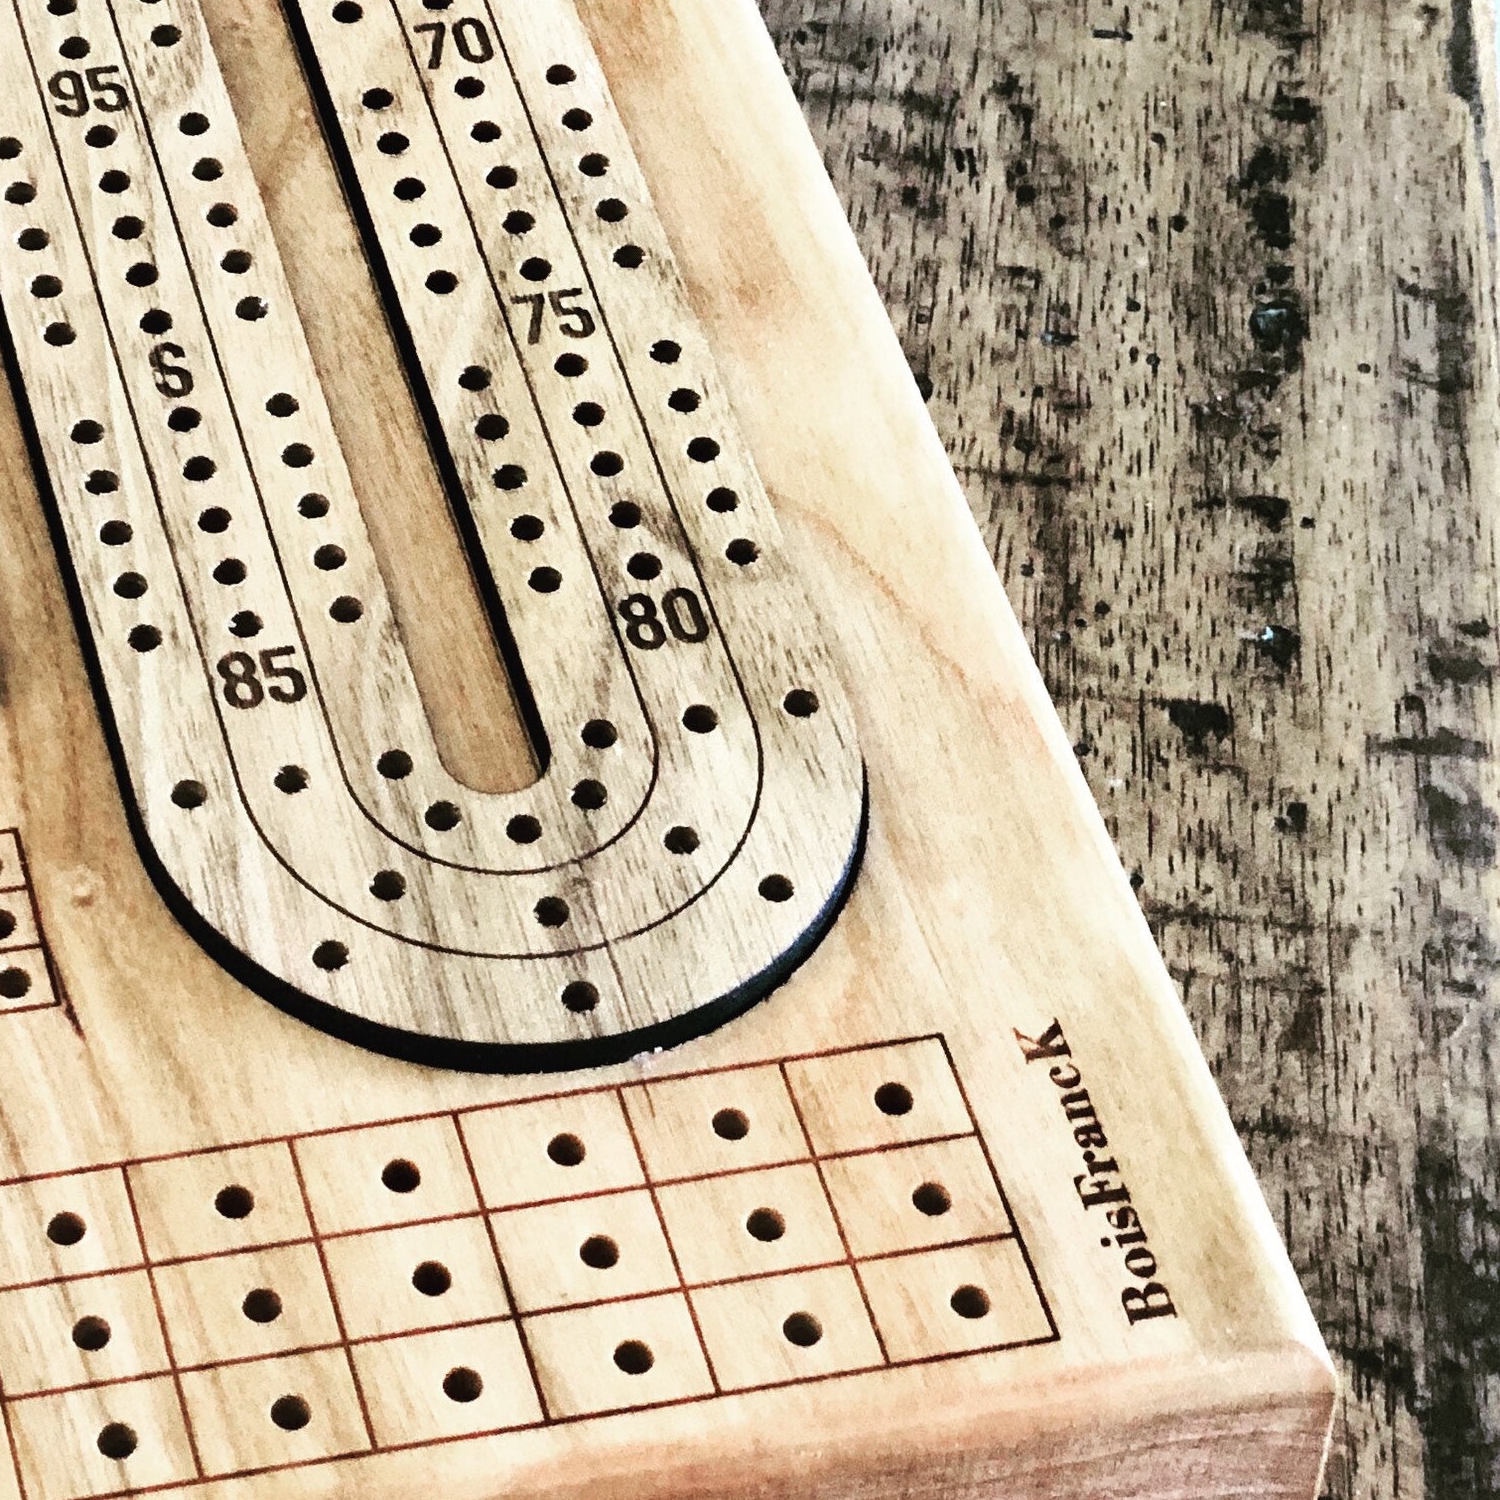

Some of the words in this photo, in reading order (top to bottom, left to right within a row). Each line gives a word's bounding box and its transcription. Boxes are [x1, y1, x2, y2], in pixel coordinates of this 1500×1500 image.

[413, 16, 495, 70] 70
[48, 64, 131, 118] 95
[509, 287, 597, 345] 75
[618, 586, 711, 651] 80
[216, 646, 308, 710] 85
